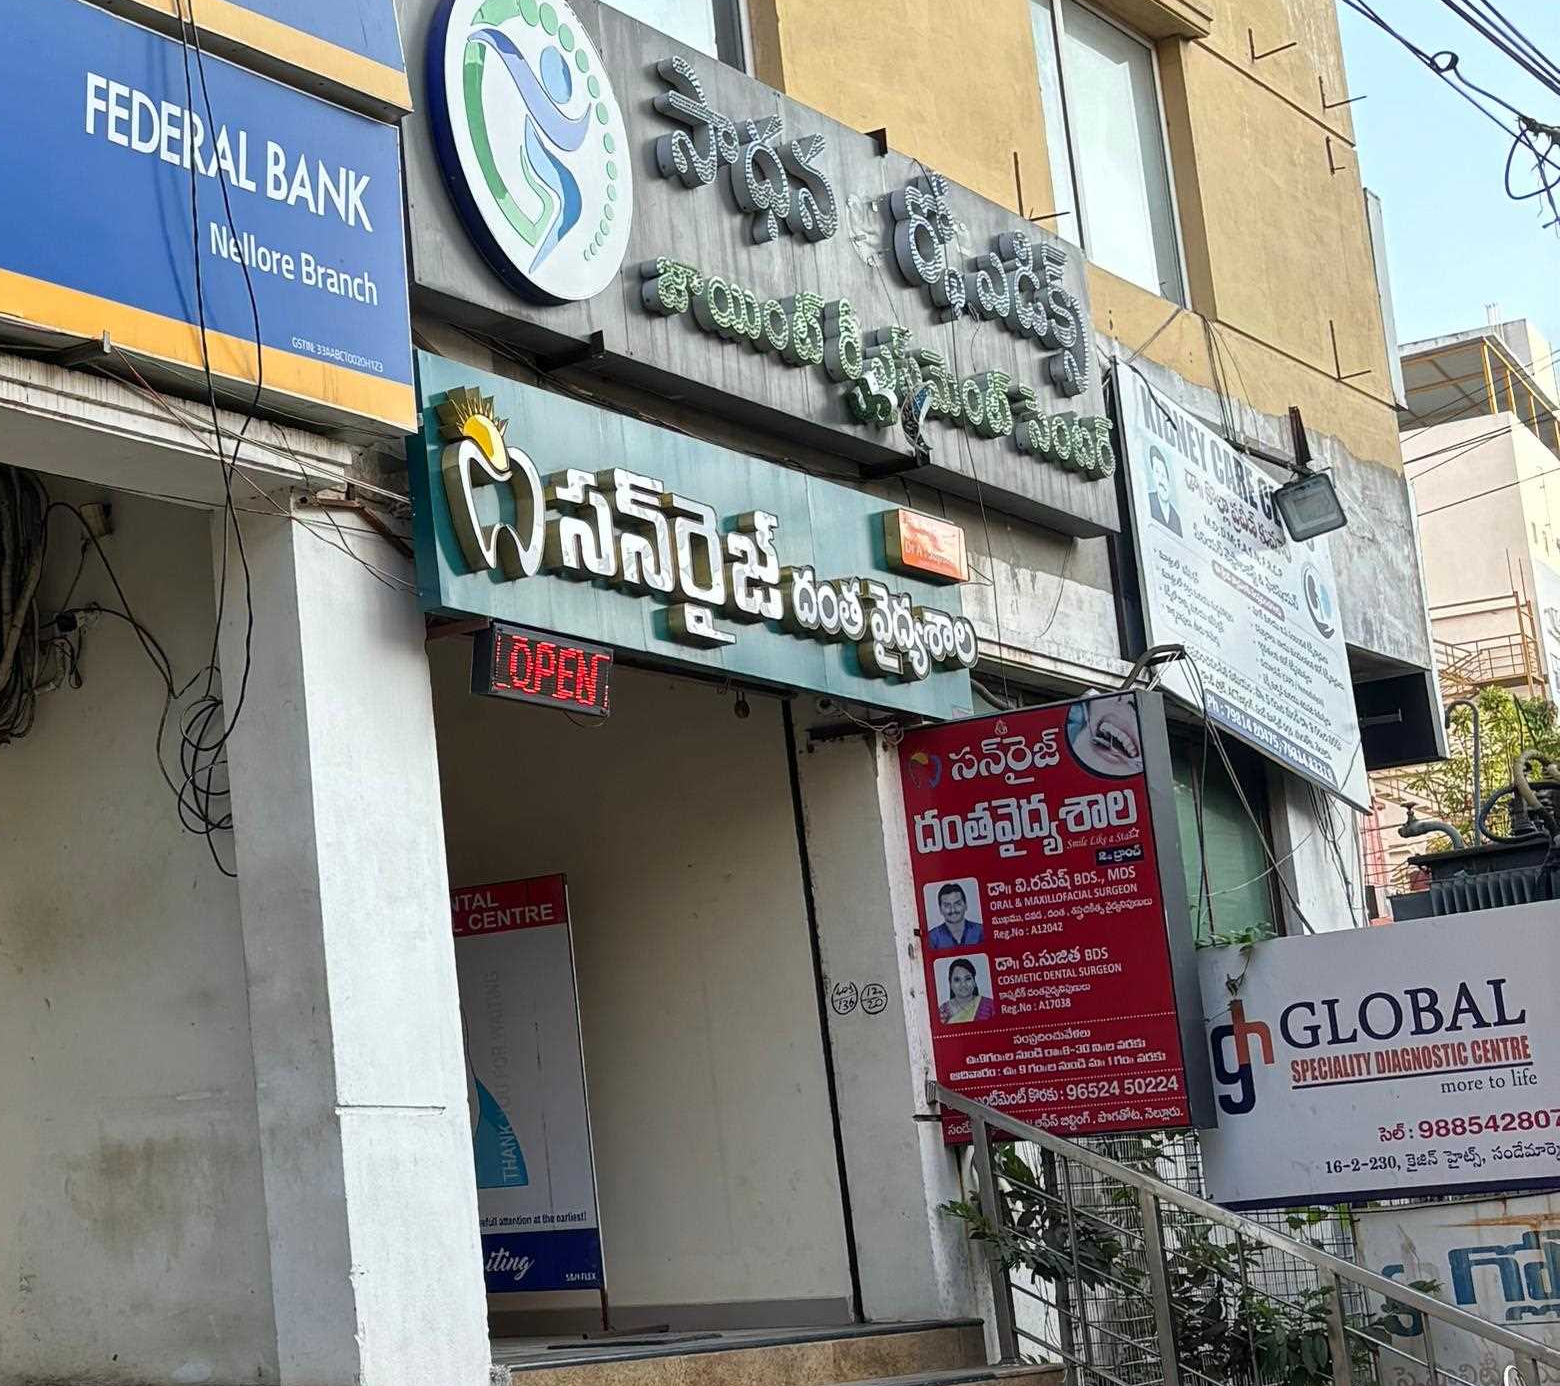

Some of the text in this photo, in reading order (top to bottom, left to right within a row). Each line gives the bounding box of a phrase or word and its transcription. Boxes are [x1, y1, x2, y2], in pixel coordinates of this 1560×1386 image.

[86, 72, 374, 232] FEDERAL BANK
[209, 221, 378, 306] Nellore Branch
[509, 634, 599, 708] OPEN
[1107, 865, 1137, 882] MDS
[990, 883, 1138, 911] ORAL & MAXILLOFACIAL SURGEON
[468, 902, 555, 931] CENTRE
[1084, 946, 1109, 961] BDS
[998, 963, 1122, 985] COSMETIC DENTAL SURGEON
[1280, 978, 1526, 1049] GLOBAL
[1291, 1035, 1531, 1083] SPECIALITY DIAGNOSTIC CENTRE
[1066, 1082, 1120, 1100] 96524
[1124, 1075, 1179, 1095] 50224
[1441, 1068, 1538, 1094] more to life
